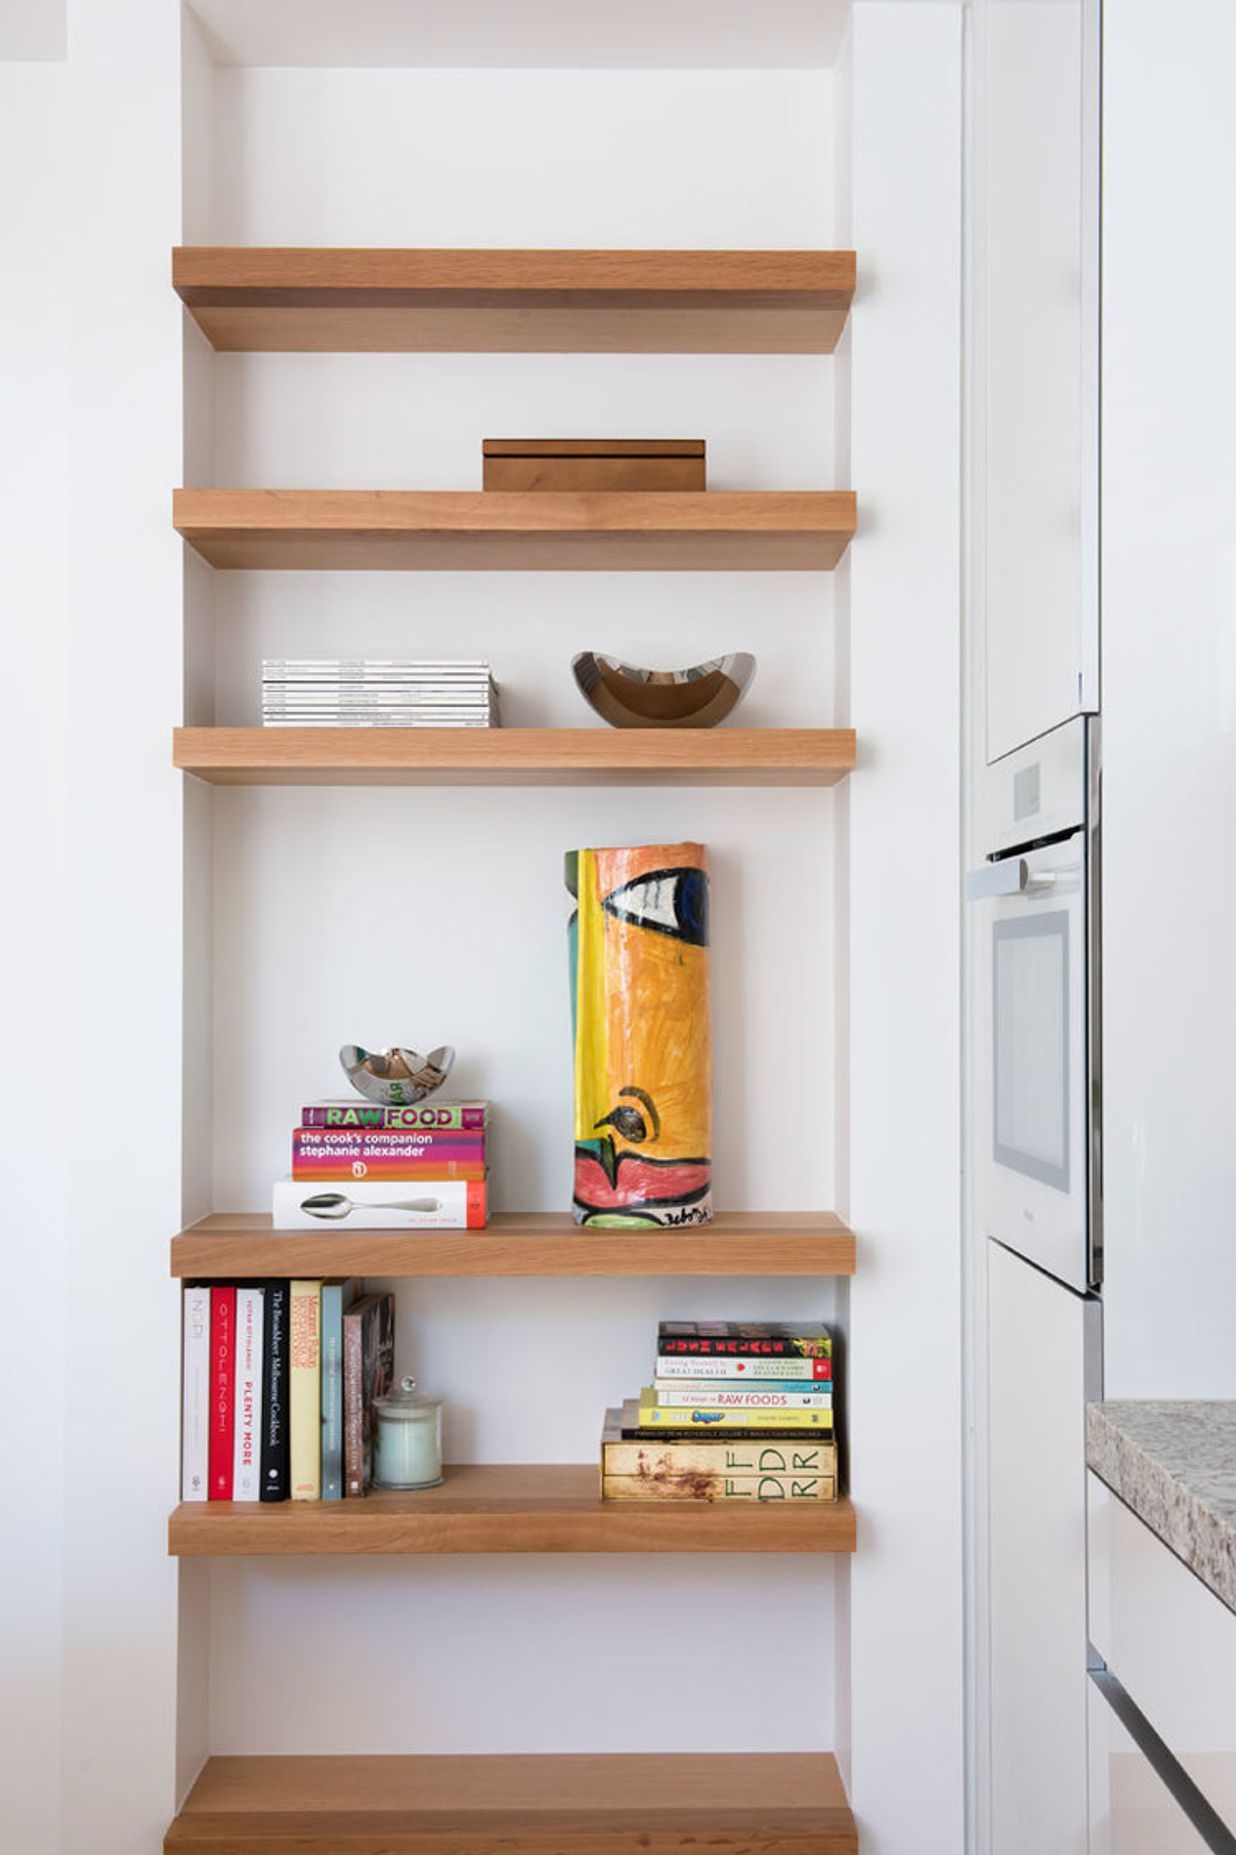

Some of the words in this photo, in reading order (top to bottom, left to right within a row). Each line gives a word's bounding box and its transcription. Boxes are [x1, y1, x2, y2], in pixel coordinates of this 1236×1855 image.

[326, 1108, 382, 1125] RAW
[386, 1108, 453, 1126] FOOD
[299, 1145, 360, 1158] stephanie
[363, 1145, 425, 1157] alexander
[300, 1132, 321, 1144] the
[324, 1131, 362, 1144] cook's
[364, 1132, 433, 1146] companion
[272, 1290, 283, 1309] The
[218, 1302, 229, 1434] OTTOLENGHI
[270, 1357, 282, 1402] Melbourne
[243, 1381, 253, 1428] PLENTY
[717, 1394, 744, 1405] RAW
[745, 1394, 788, 1406] FOODS
[268, 1403, 281, 1447] Cookbook
[242, 1431, 252, 1466] MORE
